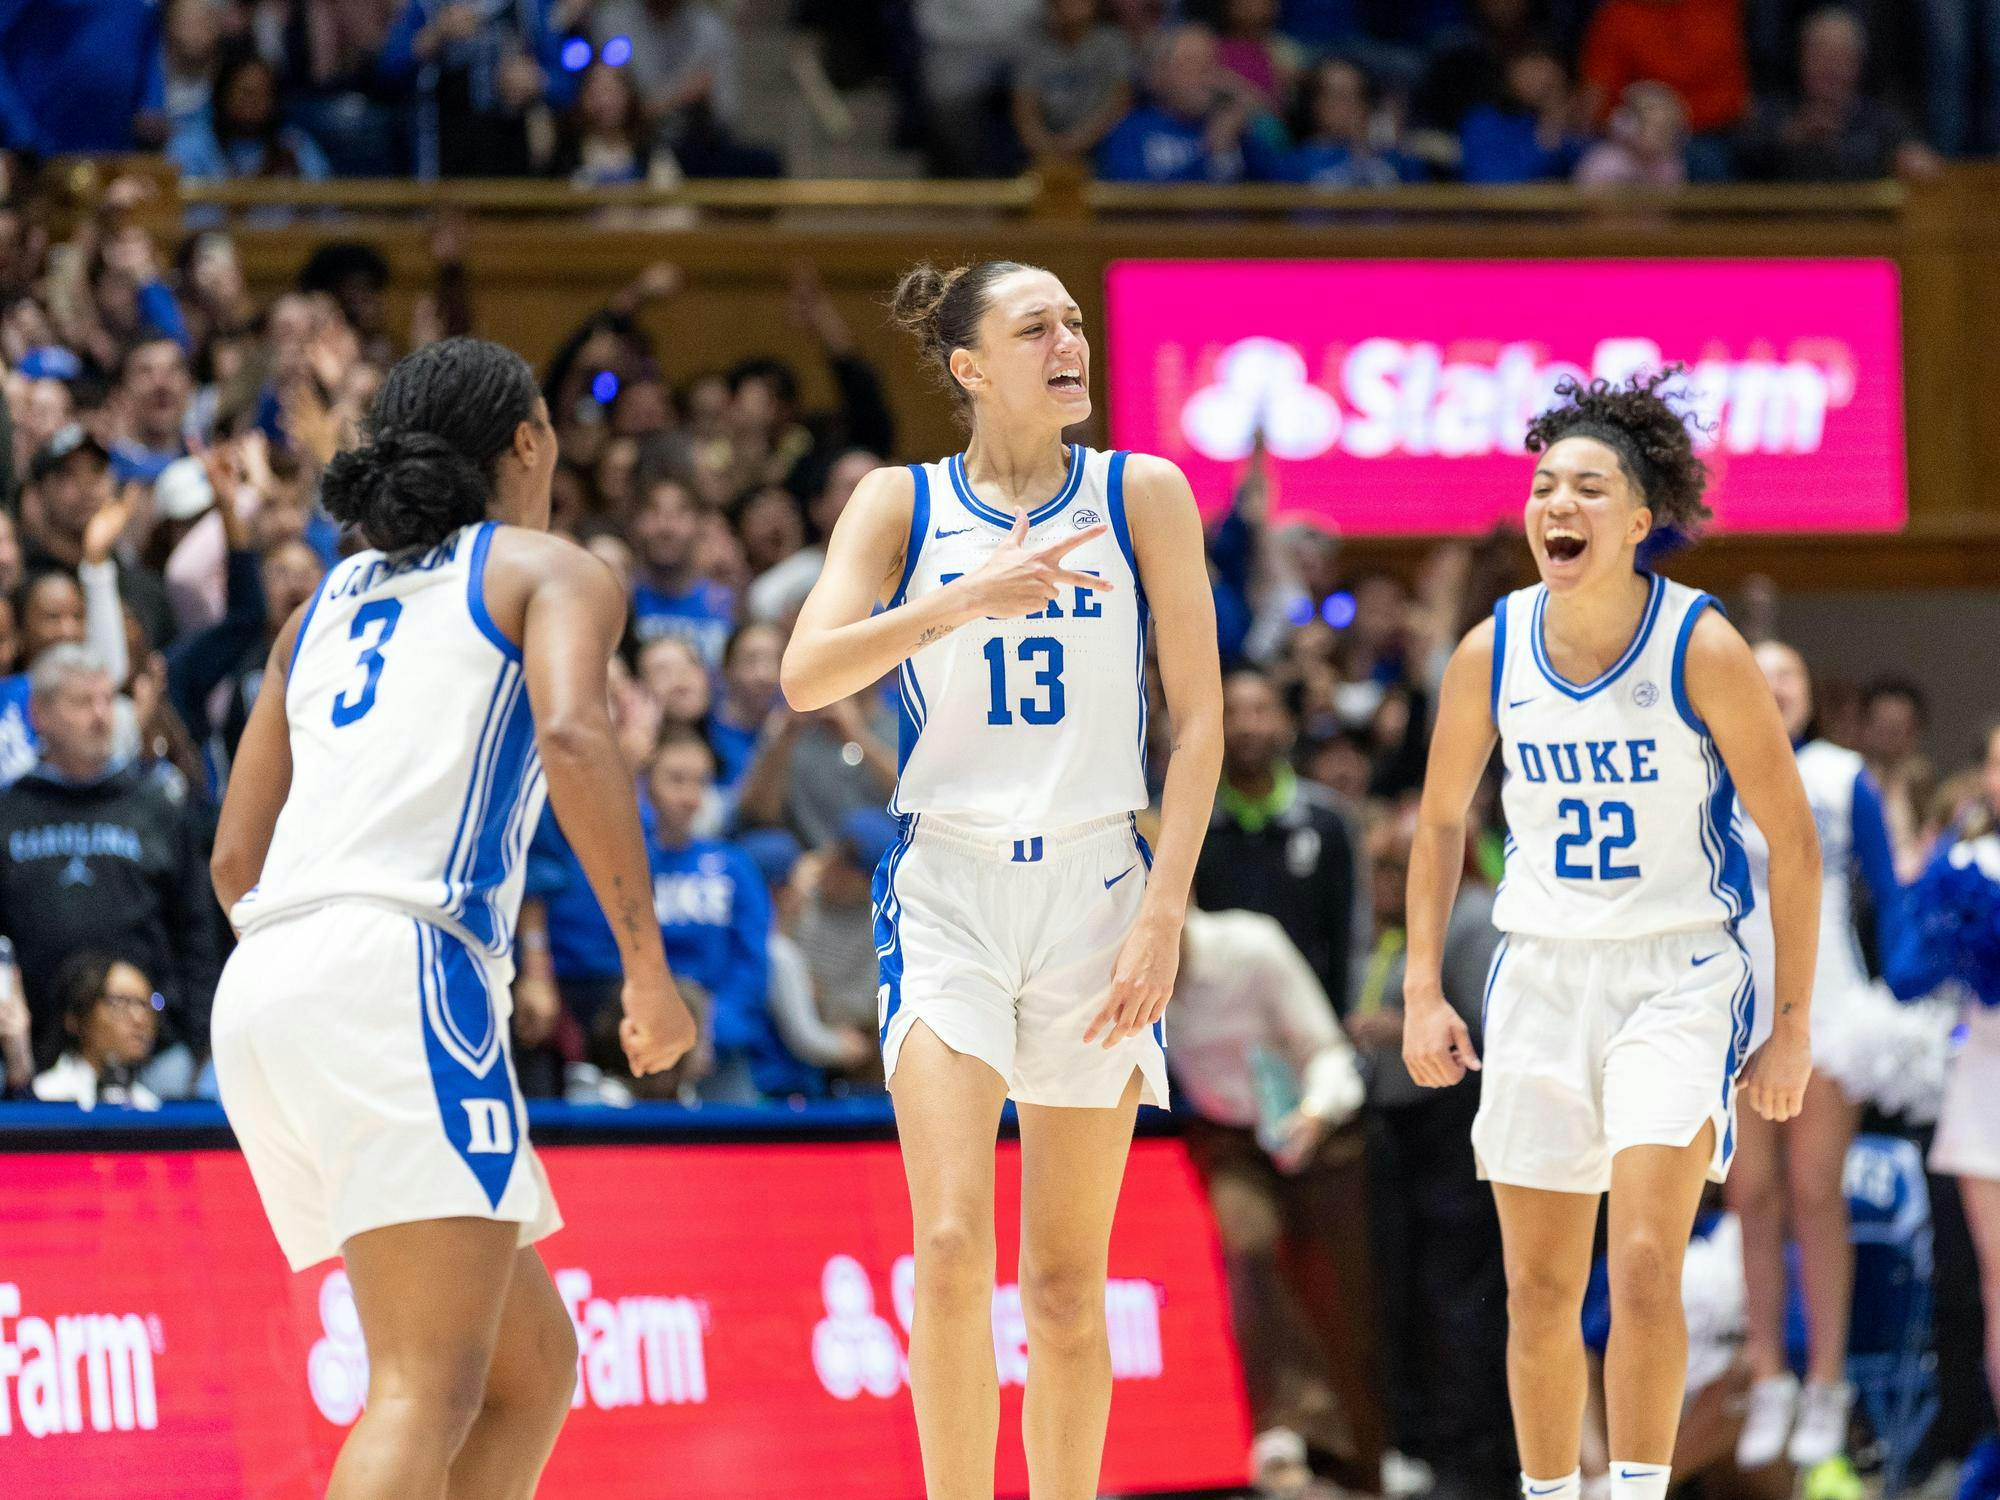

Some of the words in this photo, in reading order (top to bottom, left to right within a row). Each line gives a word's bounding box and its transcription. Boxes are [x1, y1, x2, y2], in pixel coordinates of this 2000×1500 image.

[331, 597, 403, 728] 3
[983, 637, 1066, 725] 13
[1517, 739, 1659, 783] DUKE
[1555, 798, 1641, 880] 22
[460, 1098, 513, 1153] D
